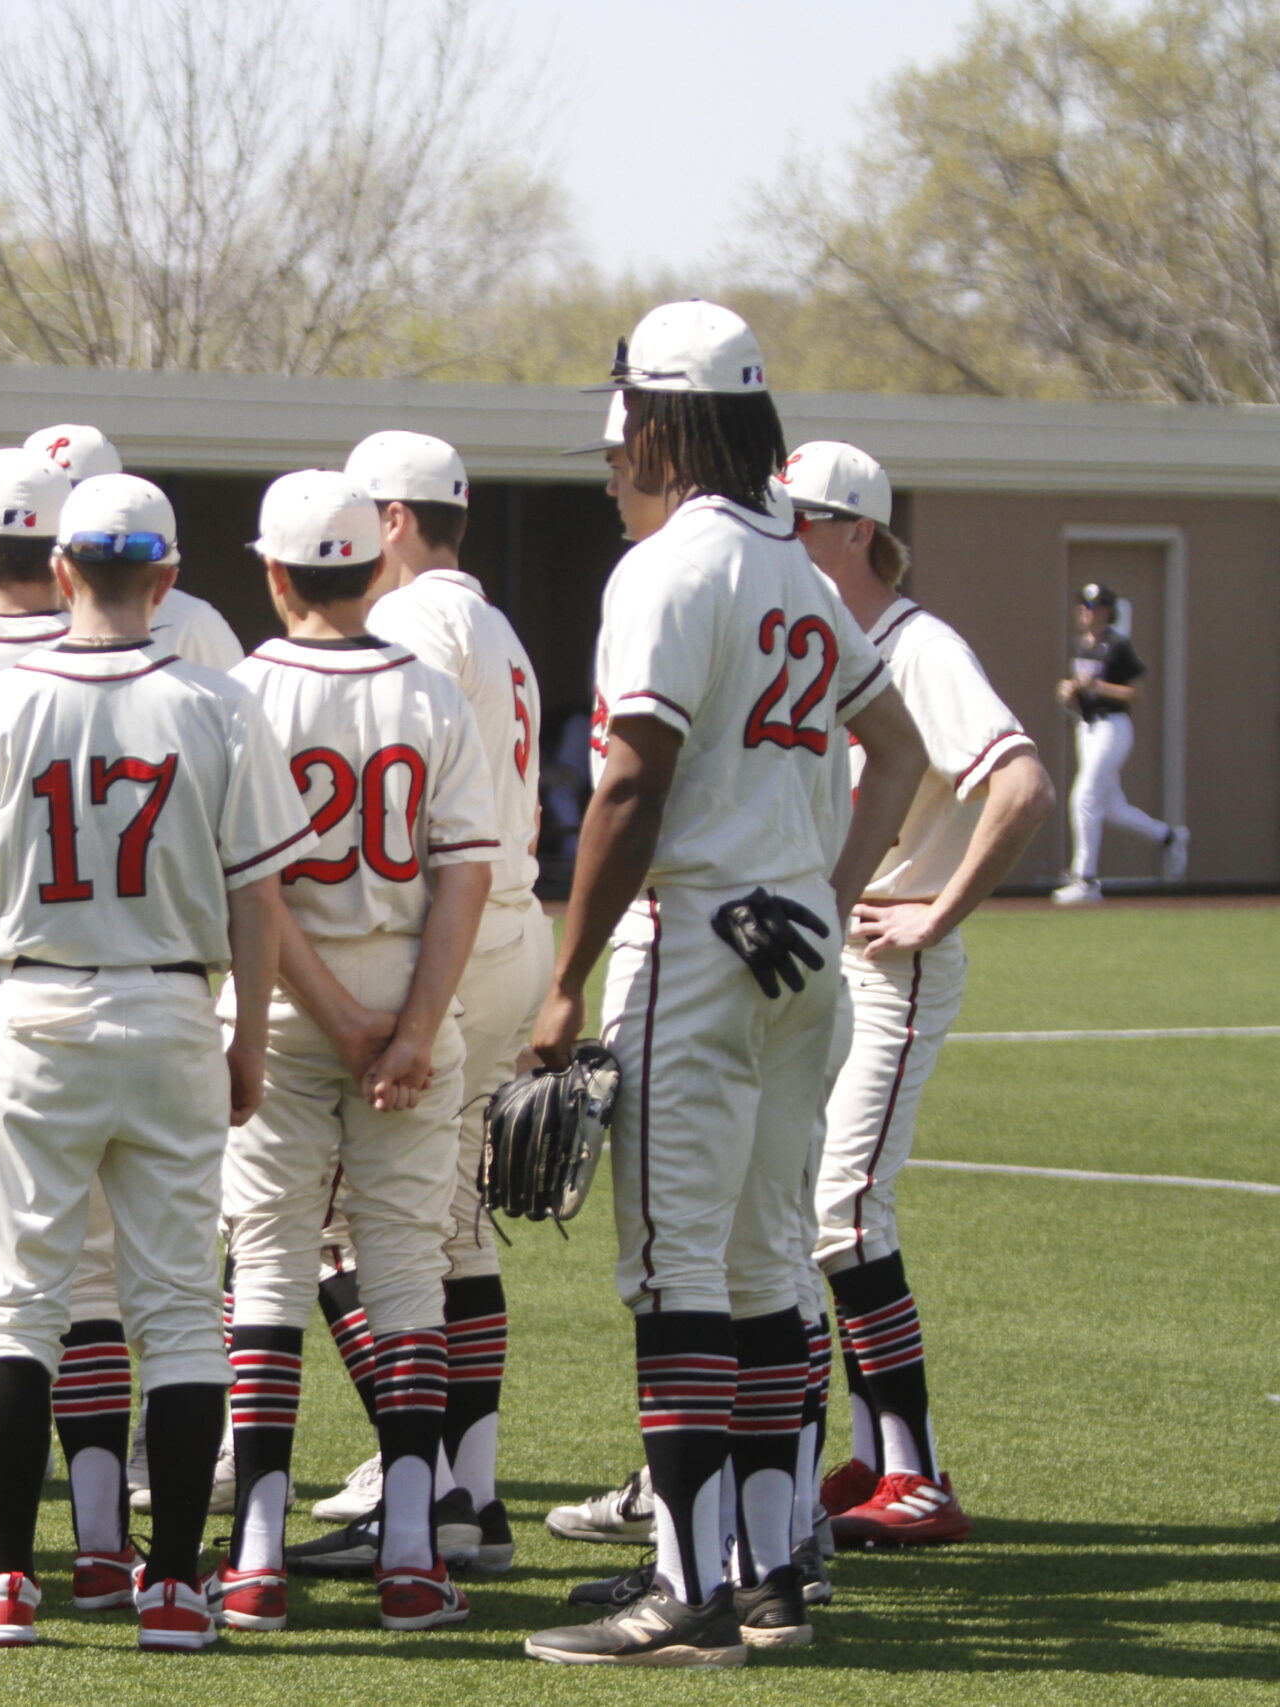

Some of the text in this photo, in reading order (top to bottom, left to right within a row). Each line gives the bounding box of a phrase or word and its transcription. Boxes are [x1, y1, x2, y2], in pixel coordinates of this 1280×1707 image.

[743, 607, 839, 757] 22
[31, 753, 179, 905] 17
[281, 743, 428, 884] 20
